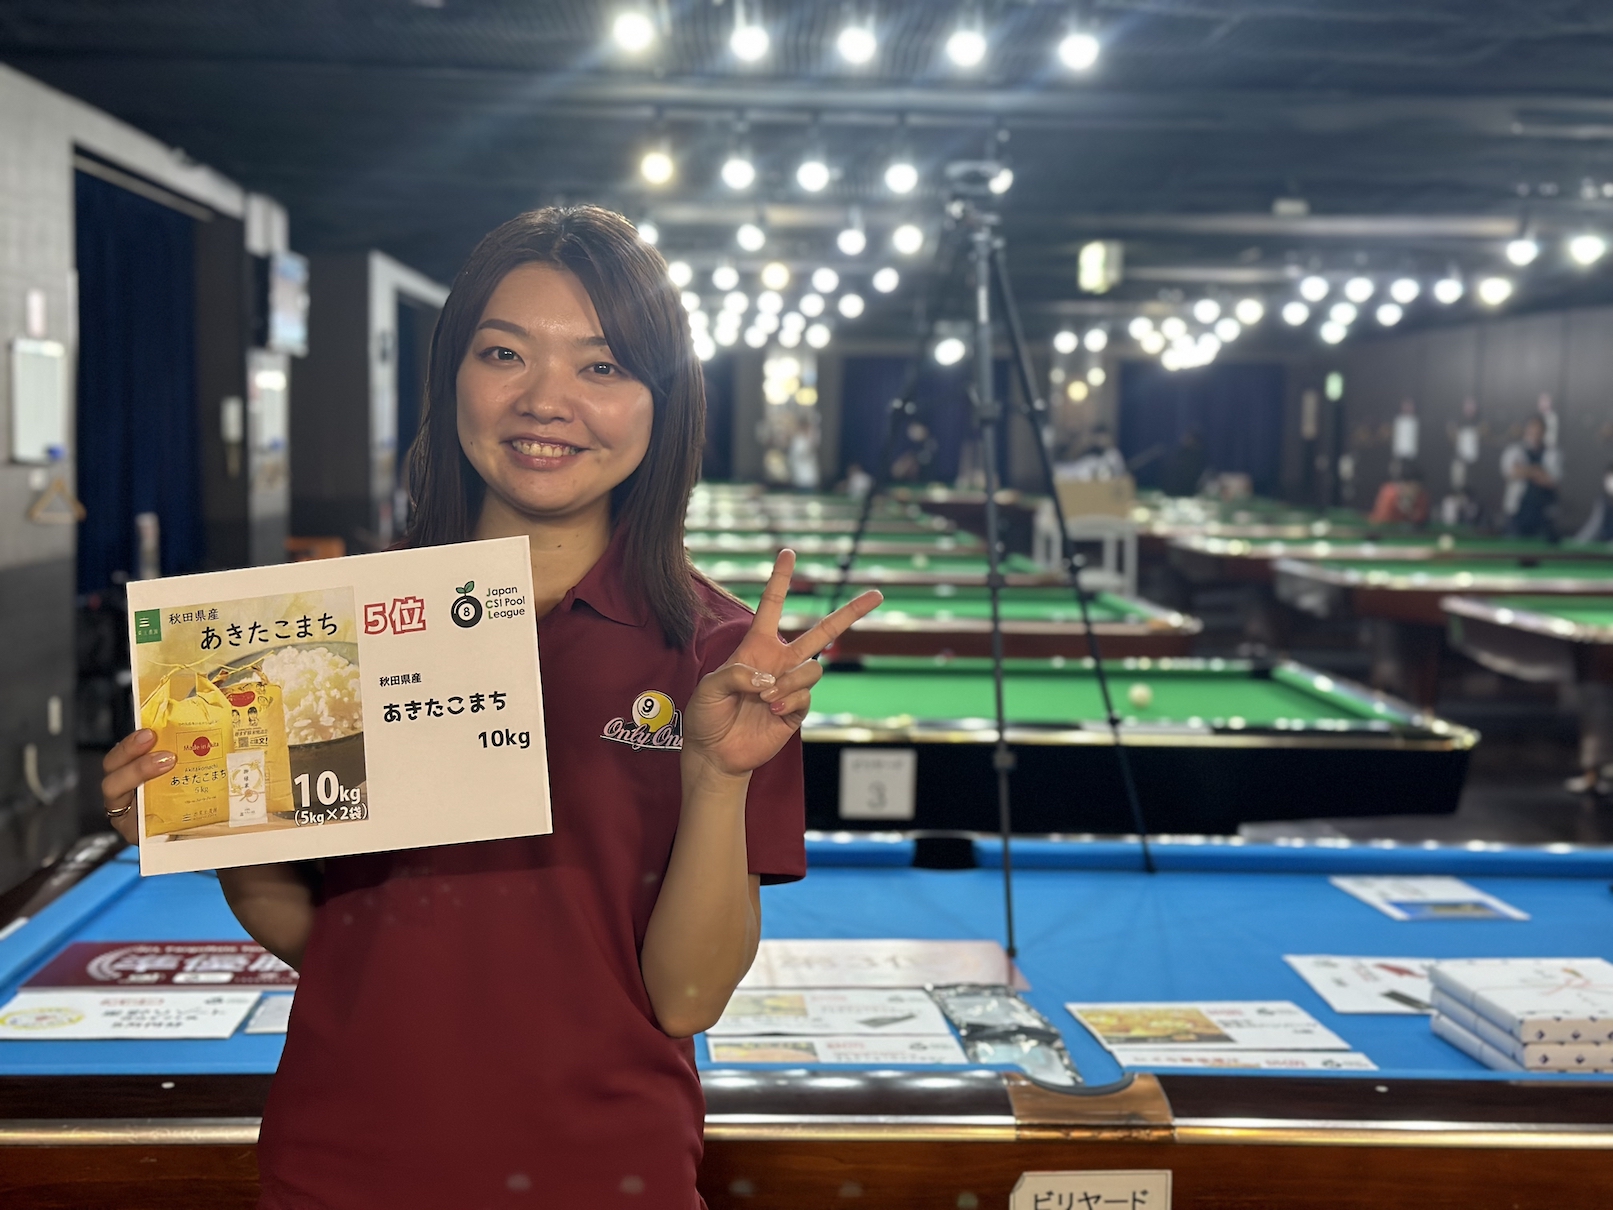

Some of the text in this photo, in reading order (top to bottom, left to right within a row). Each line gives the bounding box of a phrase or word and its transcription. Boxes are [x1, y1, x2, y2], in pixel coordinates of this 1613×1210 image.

[486, 586, 518, 597] Japan
[463, 606, 471, 617] 8
[485, 596, 526, 609] CSI Pool
[169, 608, 219, 625] 秋田県産
[364, 596, 427, 635] 5位
[488, 608, 526, 620] League
[200, 612, 338, 650] あきたこまち
[379, 673, 422, 687] 秋田県産
[383, 690, 507, 723] あきたこまち
[642, 698, 655, 713] 9
[478, 728, 530, 749] 10kg
[603, 717, 651, 750] Only
[171, 769, 226, 786] あきたこまち
[293, 769, 361, 808] 10kg
[867, 780, 888, 810] 3
[1034, 1190, 1149, 1210] ビリヤード
